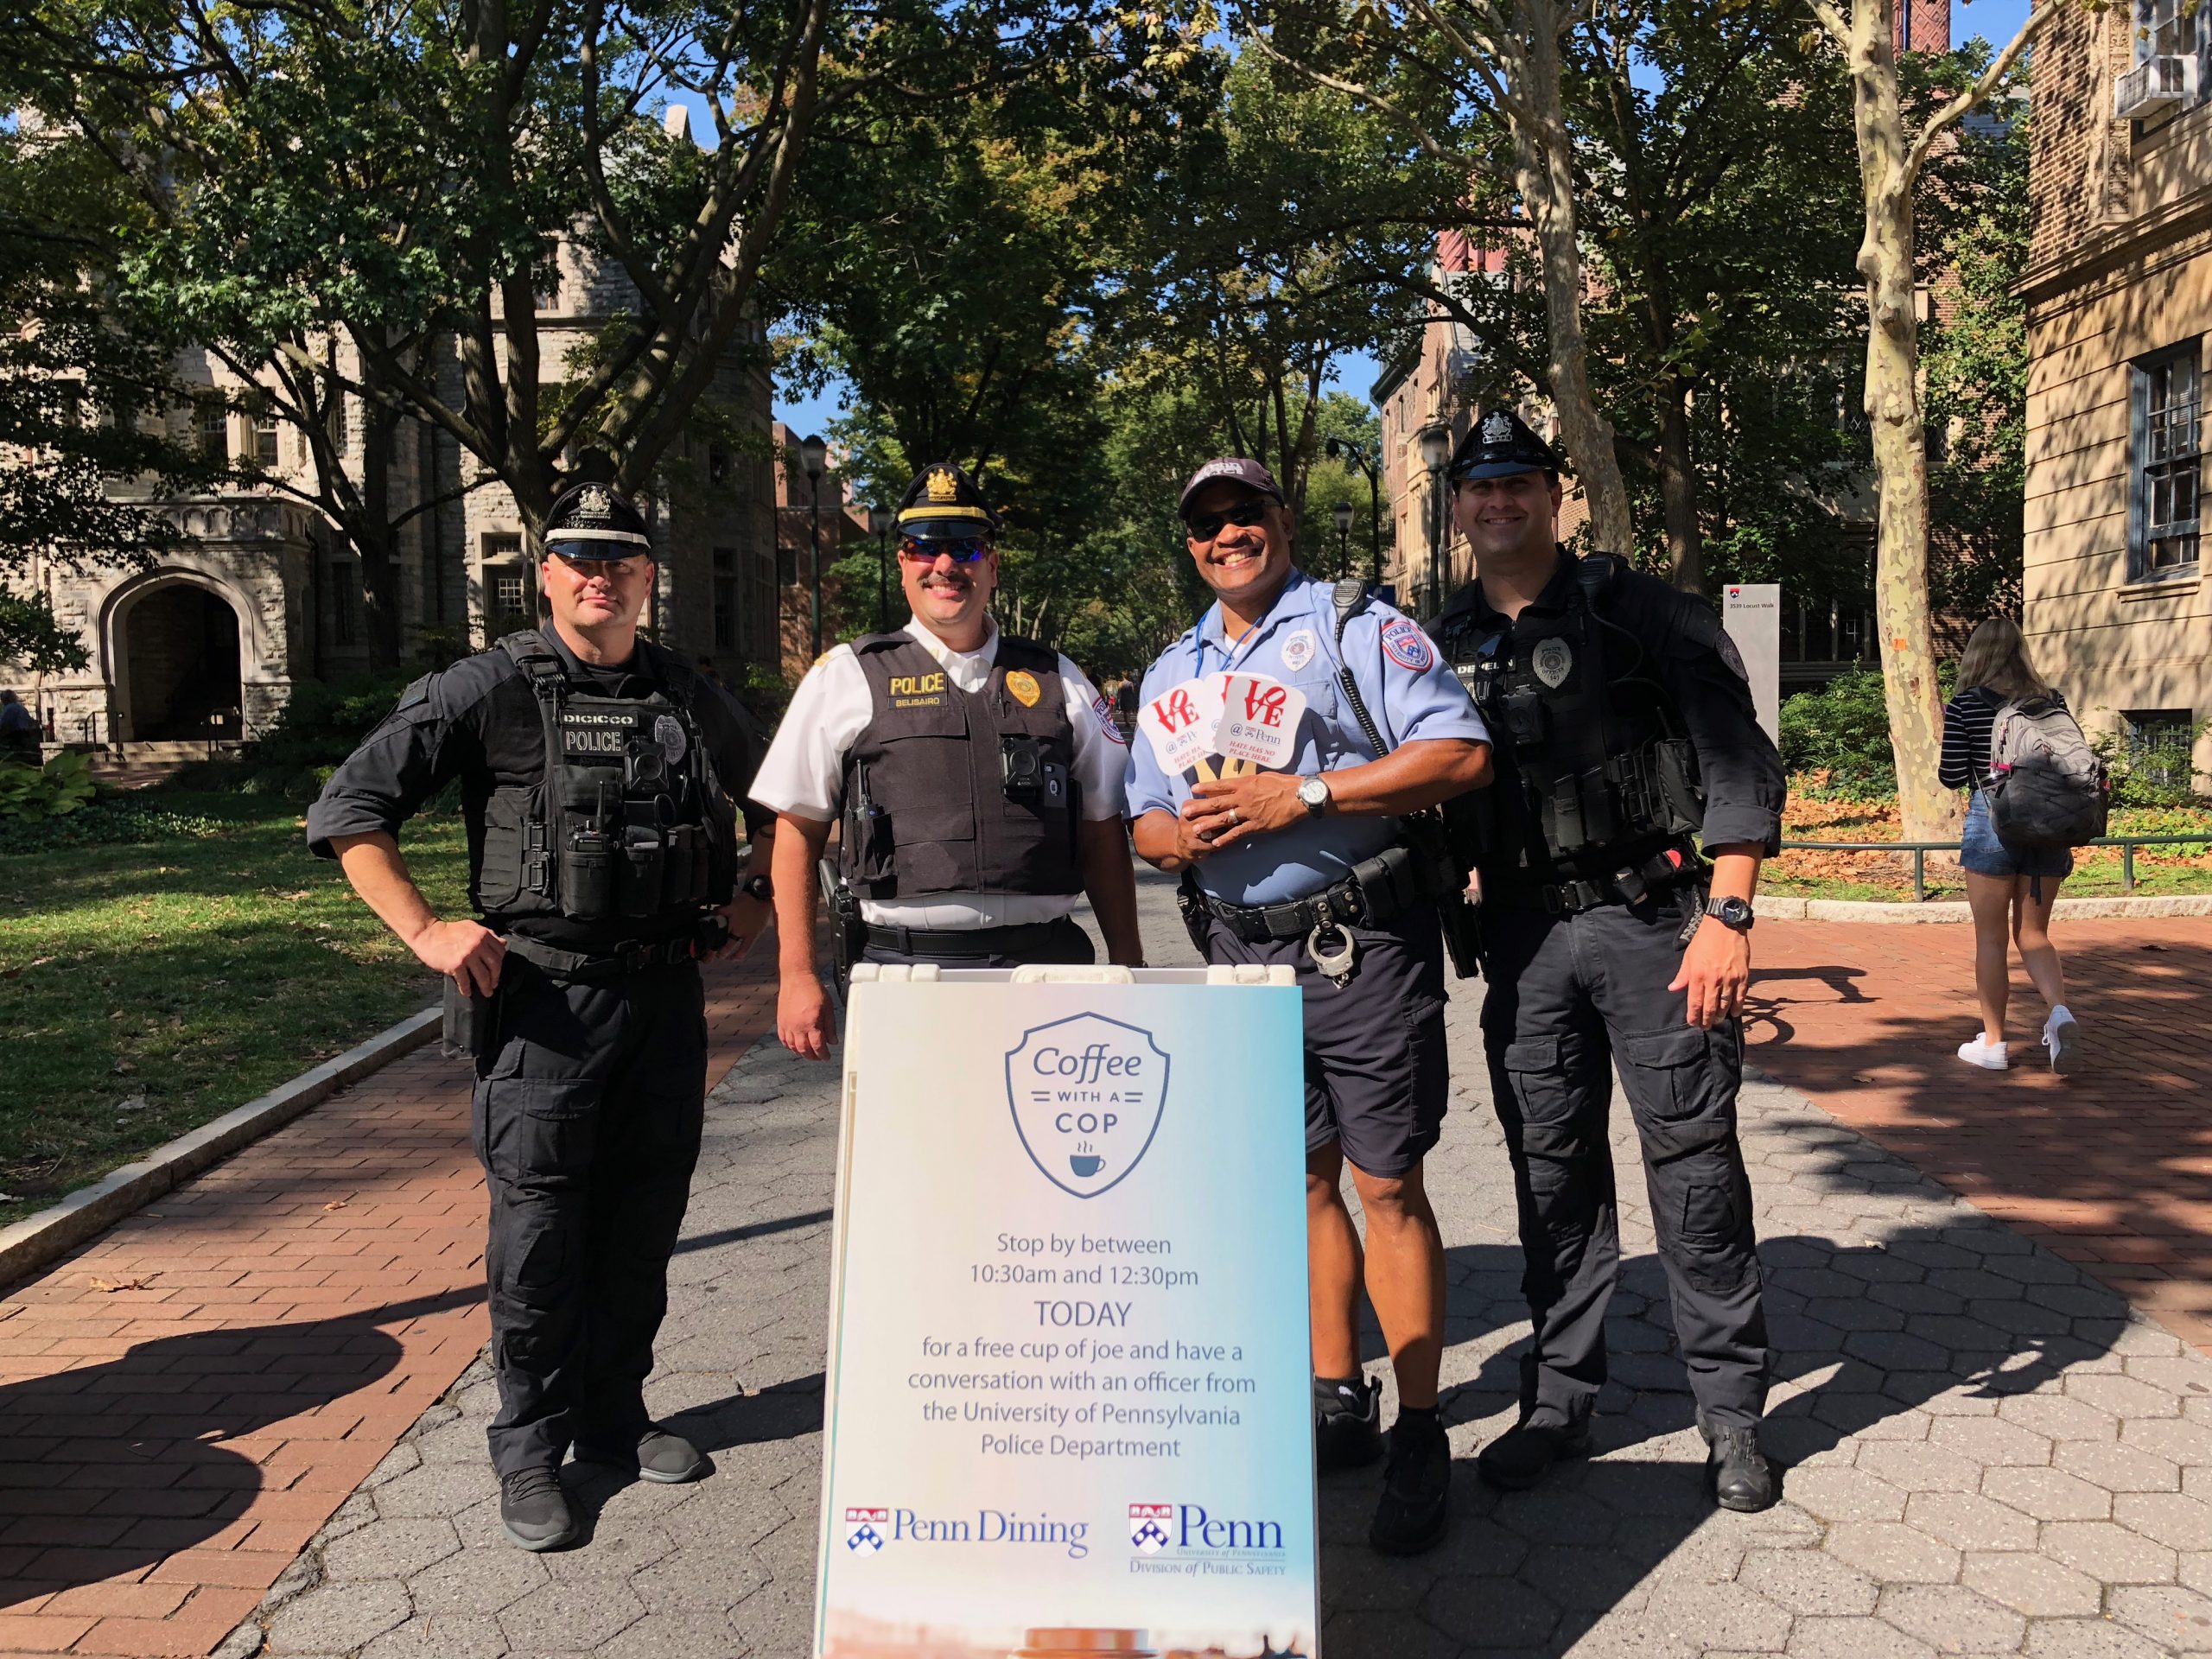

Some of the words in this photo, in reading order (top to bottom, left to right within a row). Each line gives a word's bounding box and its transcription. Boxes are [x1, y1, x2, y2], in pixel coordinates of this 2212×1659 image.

[1385, 626, 1411, 640] POLICE
[890, 673, 944, 695] POLICE
[896, 696, 940, 707] BELISAIRO
[564, 715, 633, 724] DICICCO
[566, 731, 621, 752] POLICE
[1230, 741, 1248, 750] HATE
[1249, 745, 1262, 753] HAS
[1256, 728, 1281, 745] Penn
[1229, 747, 1249, 757] PLACE
[1033, 1043, 1142, 1084] Coffee
[1058, 1090, 1101, 1103] WITH
[1109, 1090, 1120, 1103] A
[1055, 1112, 1119, 1135] COP
[997, 1233, 1044, 1257] Stop
[1051, 1233, 1076, 1258] by
[1082, 1233, 1172, 1255] between
[970, 1263, 1057, 1285] 10:30am
[1063, 1263, 1103, 1285] and
[1109, 1265, 1198, 1291] 12:30pm
[1033, 1300, 1134, 1328] TODAY
[922, 1336, 952, 1357] for
[957, 1341, 969, 1357] a
[975, 1337, 1014, 1358] free
[1020, 1343, 1059, 1363] cup
[1065, 1338, 1089, 1359] of
[1090, 1338, 1124, 1363] joe
[1130, 1338, 1170, 1360] and
[1177, 1339, 1225, 1362] have
[1232, 1345, 1243, 1362] a
[908, 1369, 1043, 1391] conversation
[1050, 1369, 1096, 1392] with
[1103, 1375, 1128, 1392] an
[1134, 1370, 1200, 1393] officer
[1206, 1371, 1255, 1394] from
[923, 1401, 957, 1422] the
[964, 1402, 1070, 1429] University
[1075, 1402, 1098, 1424] of
[1103, 1403, 1241, 1430] Pennsylvania
[982, 1433, 1044, 1456] Police
[1051, 1434, 1180, 1460] Department
[893, 1508, 970, 1543] Penn
[978, 1510, 1090, 1560] Dining
[1178, 1503, 1286, 1548] Penn
[1130, 1560, 1181, 1573] DIVISION
[1185, 1561, 1200, 1577] of
[1203, 1562, 1243, 1574] PUBLIC
[1247, 1562, 1286, 1575] SAFETY
